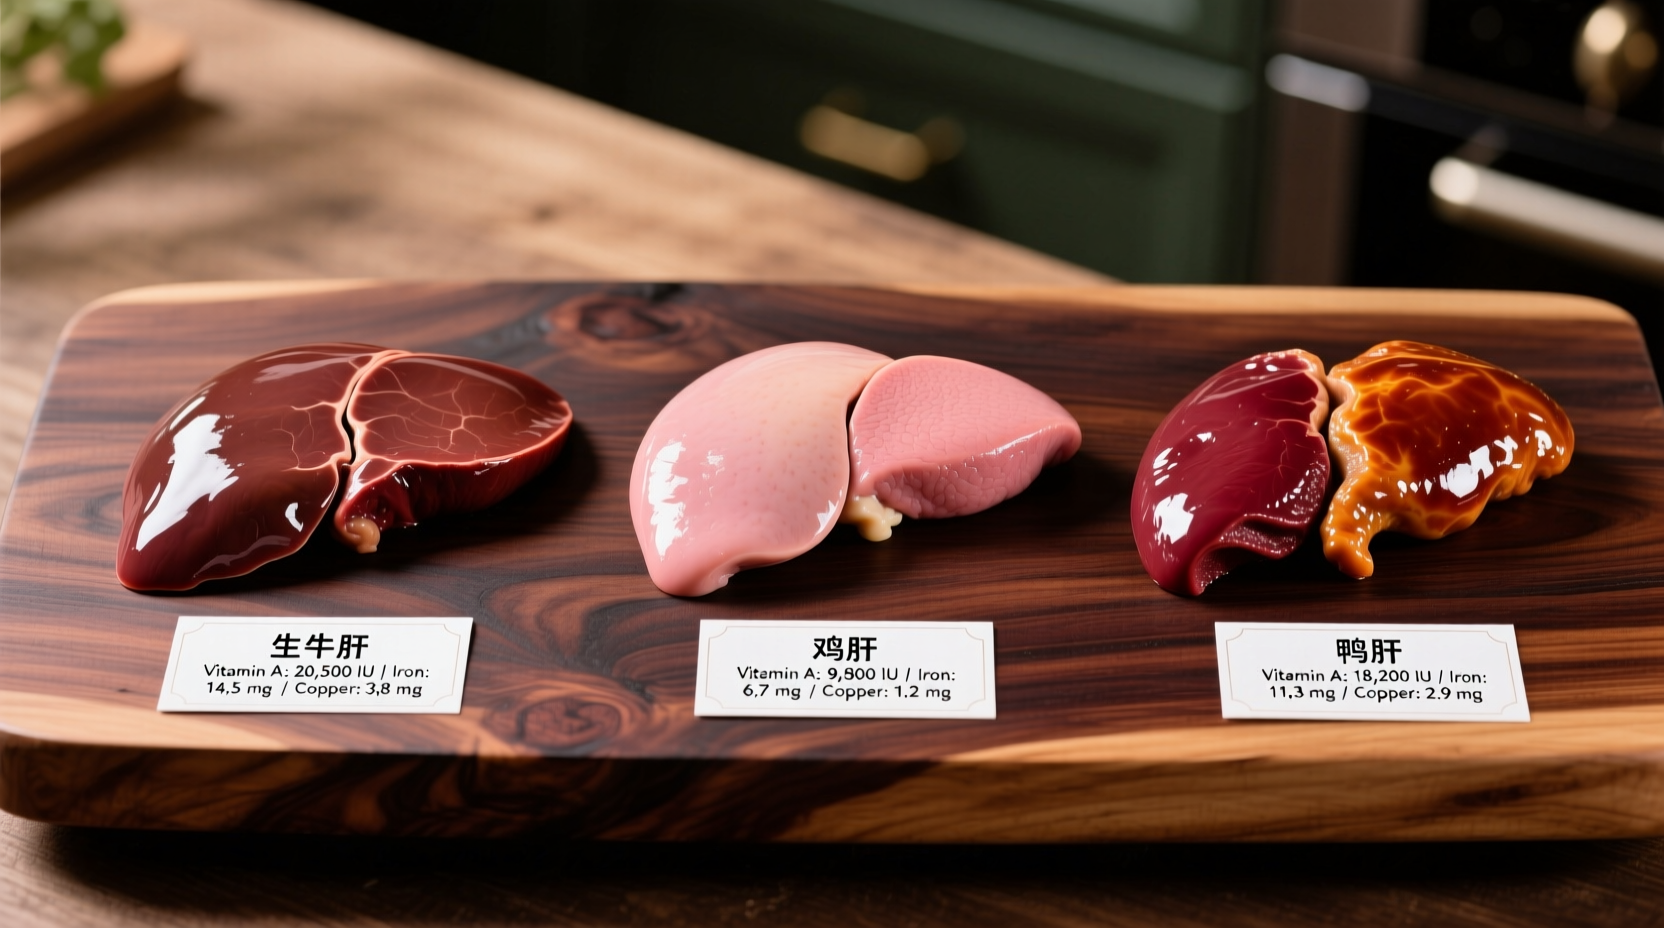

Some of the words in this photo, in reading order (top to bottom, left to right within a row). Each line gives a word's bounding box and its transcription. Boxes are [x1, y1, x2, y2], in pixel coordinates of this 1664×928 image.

[271, 633, 369, 659] 生牛肝
[813, 635, 877, 662] 鸡肝
[1336, 637, 1402, 664] 鸭肝
[204, 664, 265, 677] Vitamin
[271, 665, 288, 677] A:
[294, 665, 352, 680] 20,500
[358, 665, 374, 677] IU
[380, 665, 387, 680] /
[394, 665, 428, 677] Iron:
[804, 668, 820, 680] A:
[882, 668, 897, 680] IU
[905, 667, 911, 682] /
[919, 669, 955, 681] Iron:
[1262, 669, 1324, 682] Vitamin
[1330, 670, 1347, 682] A:
[1355, 670, 1409, 685] 18,200
[1416, 670, 1431, 682] IU
[1438, 670, 1443, 684] /
[1450, 671, 1486, 683] Iron:
[247, 686, 272, 697] mg
[281, 681, 288, 696] /
[295, 682, 360, 698] Copper:
[397, 686, 422, 697] mg
[776, 688, 800, 700] mg
[809, 685, 816, 699] /
[823, 685, 887, 701] Copper:
[894, 686, 918, 698] 1.2
[926, 689, 951, 701] mg
[1310, 689, 1335, 702] mg
[1342, 686, 1348, 700] /
[1355, 687, 1420, 703] Copper:
[1425, 687, 1451, 699] 2.9
[1457, 691, 1482, 703] mg
